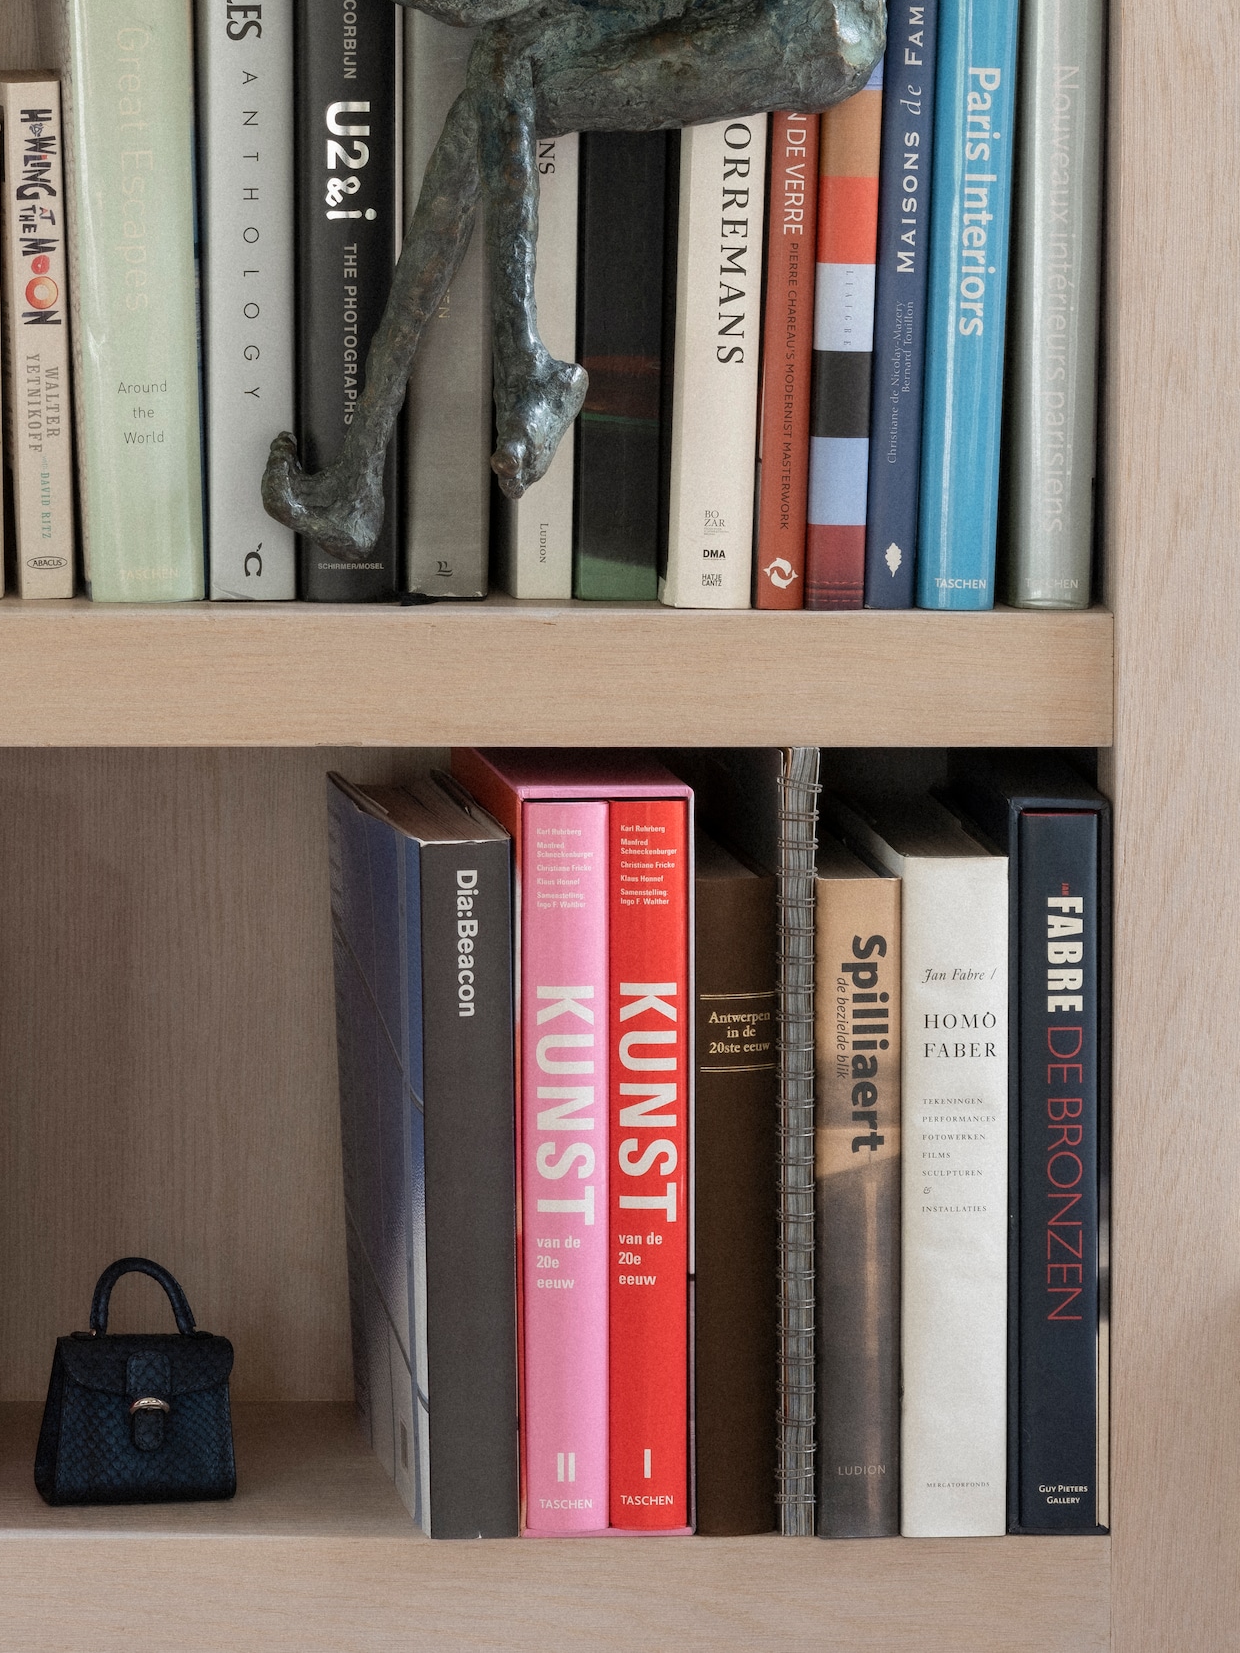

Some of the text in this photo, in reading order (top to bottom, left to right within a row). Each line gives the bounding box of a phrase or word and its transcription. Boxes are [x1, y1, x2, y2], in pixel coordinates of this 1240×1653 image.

[242, 70, 260, 399] ANTHOLOGY
[782, 128, 807, 235] DE VERRE
[895, 131, 920, 274] MAISONS
[958, 65, 1002, 337] Paris Interiors
[25, 352, 43, 454] YETNIKOFF
[44, 365, 60, 438] WALTER
[343, 284, 358, 426] PHOTOGRAPHS
[779, 363, 796, 530] MODERNIST MASTERWORK
[934, 578, 987, 589] TASCHEN
[456, 868, 479, 1018] Dia:Beacon
[709, 1011, 772, 1024] Antwerpen
[841, 934, 889, 1154] Spilliaert
[923, 1042, 998, 1058] FABER
[535, 984, 596, 1225] KUNST
[618, 981, 678, 1223] KUNST
[1046, 896, 1084, 1321] FABRE BRONZEN
[618, 1274, 657, 1286] eeuw
[620, 1495, 675, 1505] TASCHEN
[838, 1467, 887, 1476] LUDION
